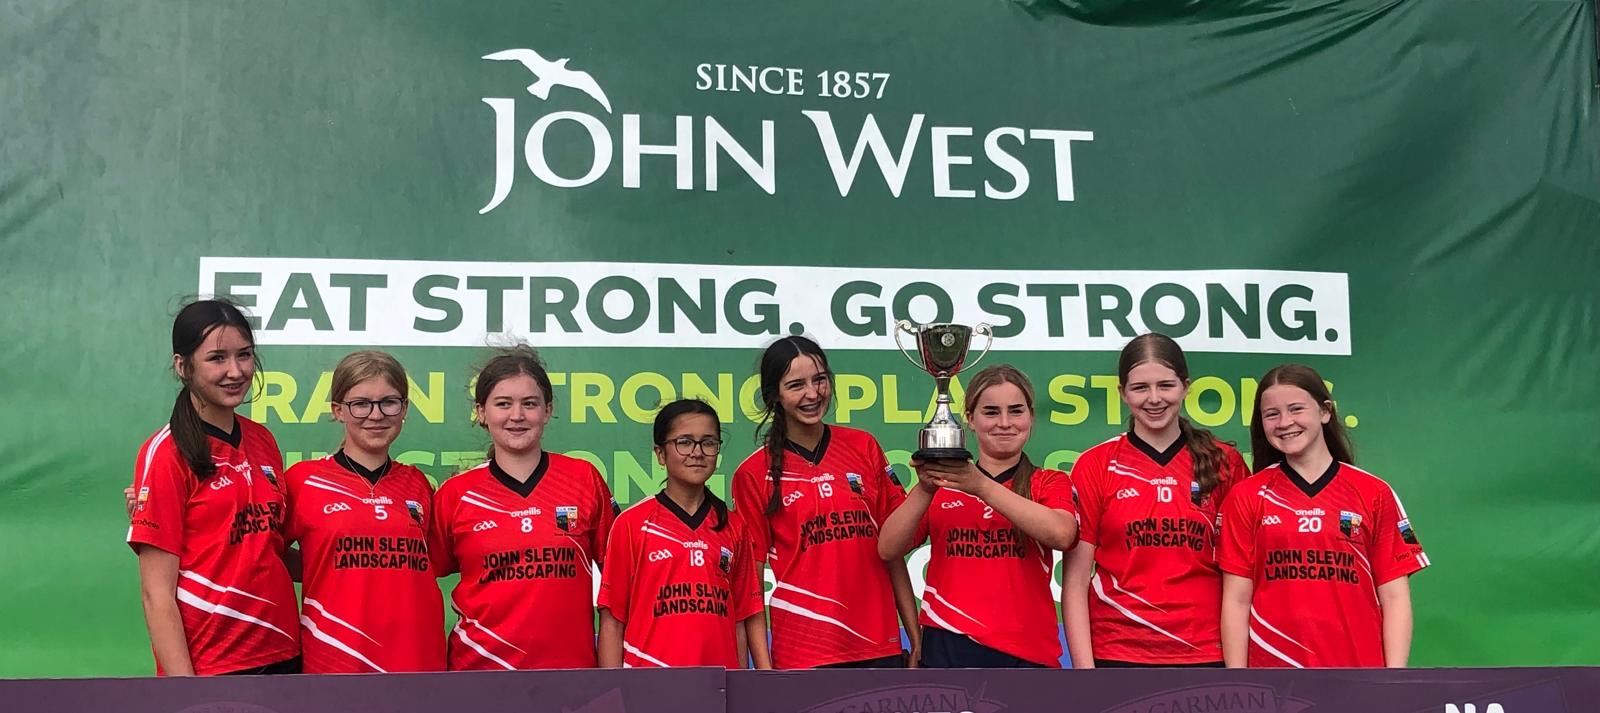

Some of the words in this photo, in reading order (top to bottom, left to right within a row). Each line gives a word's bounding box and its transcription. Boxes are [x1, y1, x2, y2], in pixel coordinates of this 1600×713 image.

[696, 63, 805, 95] SINCE
[817, 70, 891, 99] 1857
[478, 97, 776, 215] JOHN
[801, 110, 1094, 202] WEST
[213, 272, 388, 331] EAT
[412, 274, 805, 337] STRONG.
[830, 280, 954, 338] GO
[977, 282, 1339, 342] STRONG.
[817, 483, 833, 498] 19
[1157, 486, 1172, 503] 10
[374, 505, 388, 520] 5
[510, 507, 542, 518] oneills
[830, 510, 871, 525] SLEVIN
[983, 506, 994, 519] 2
[521, 517, 533, 533] 8
[1126, 518, 1157, 536] JOHN
[1161, 518, 1206, 535] SLEVIN
[1298, 517, 1322, 533] 20
[946, 528, 979, 543] JOHN
[336, 536, 374, 552] JOHN
[379, 537, 427, 554] SLEVIN
[334, 553, 428, 572] LANDSCAPING
[483, 553, 520, 570] JOHN
[525, 548, 575, 564] SLEVIN
[690, 550, 705, 566] 18
[1266, 551, 1301, 566] JOHN
[1306, 550, 1354, 566] SLEVIN
[479, 563, 577, 585] LANDSCAPING
[1265, 566, 1359, 584] LANDSCAPING
[656, 583, 692, 600] JOHN
